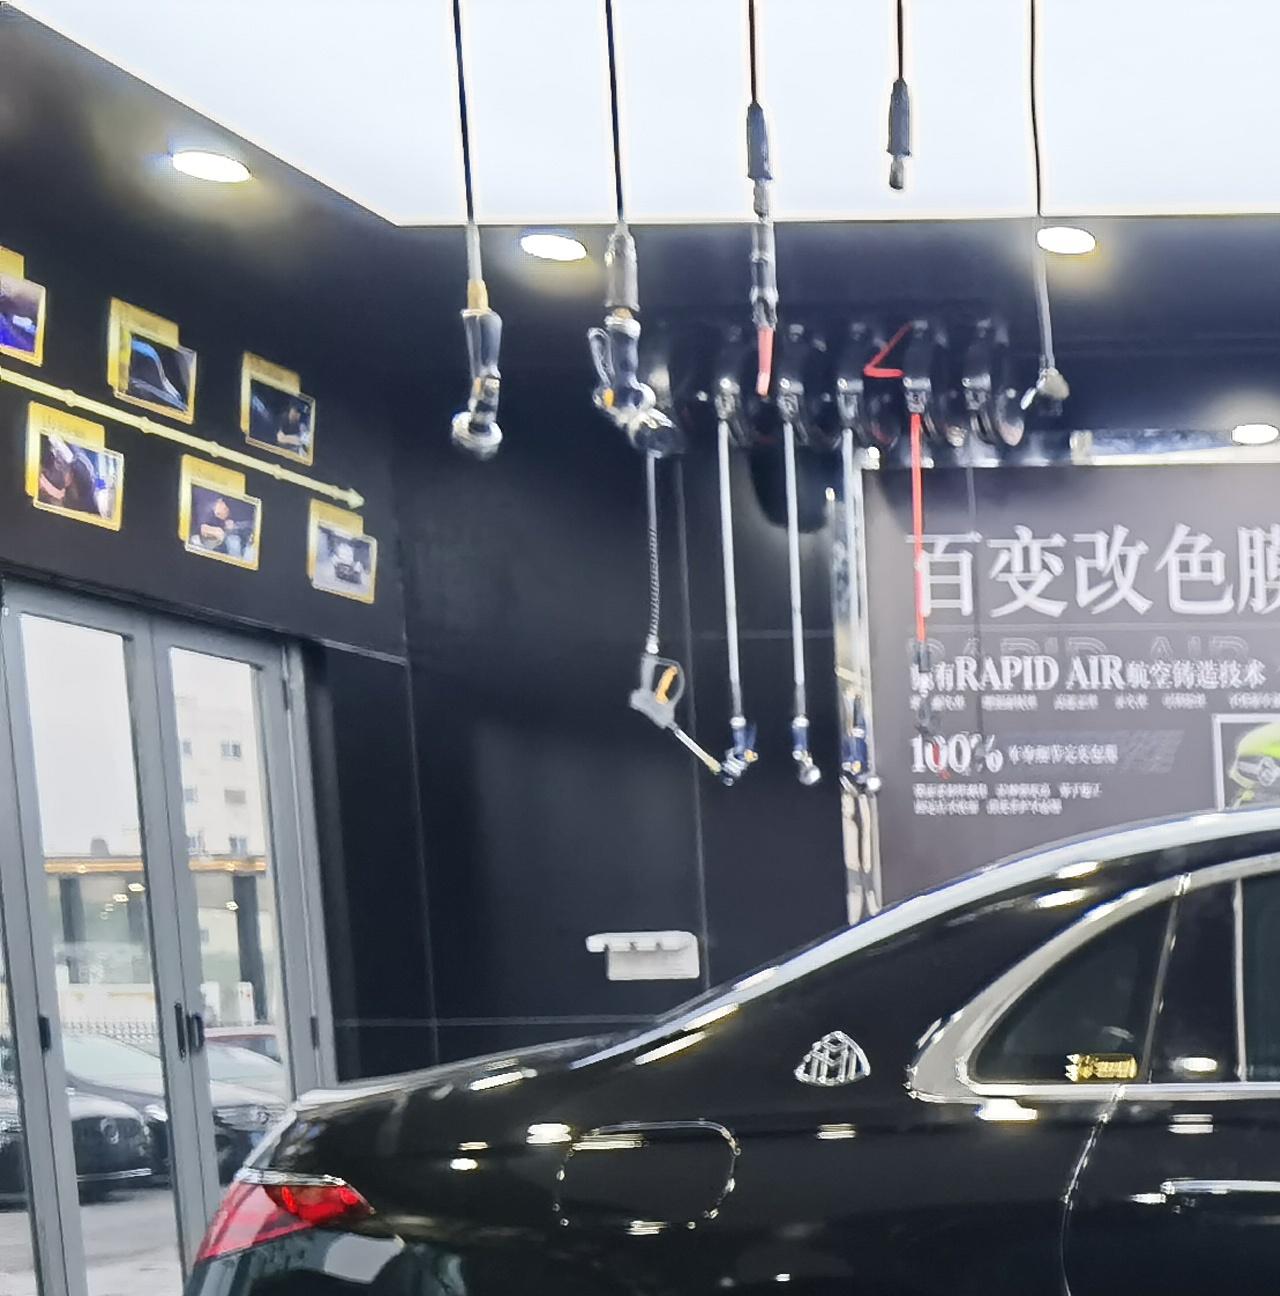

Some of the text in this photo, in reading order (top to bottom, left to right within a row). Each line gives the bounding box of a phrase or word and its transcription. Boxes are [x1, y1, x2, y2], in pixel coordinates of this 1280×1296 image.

[955, 655, 1059, 691] RAPID
[1066, 654, 1125, 691] AIR
[910, 732, 1004, 774] 100%
